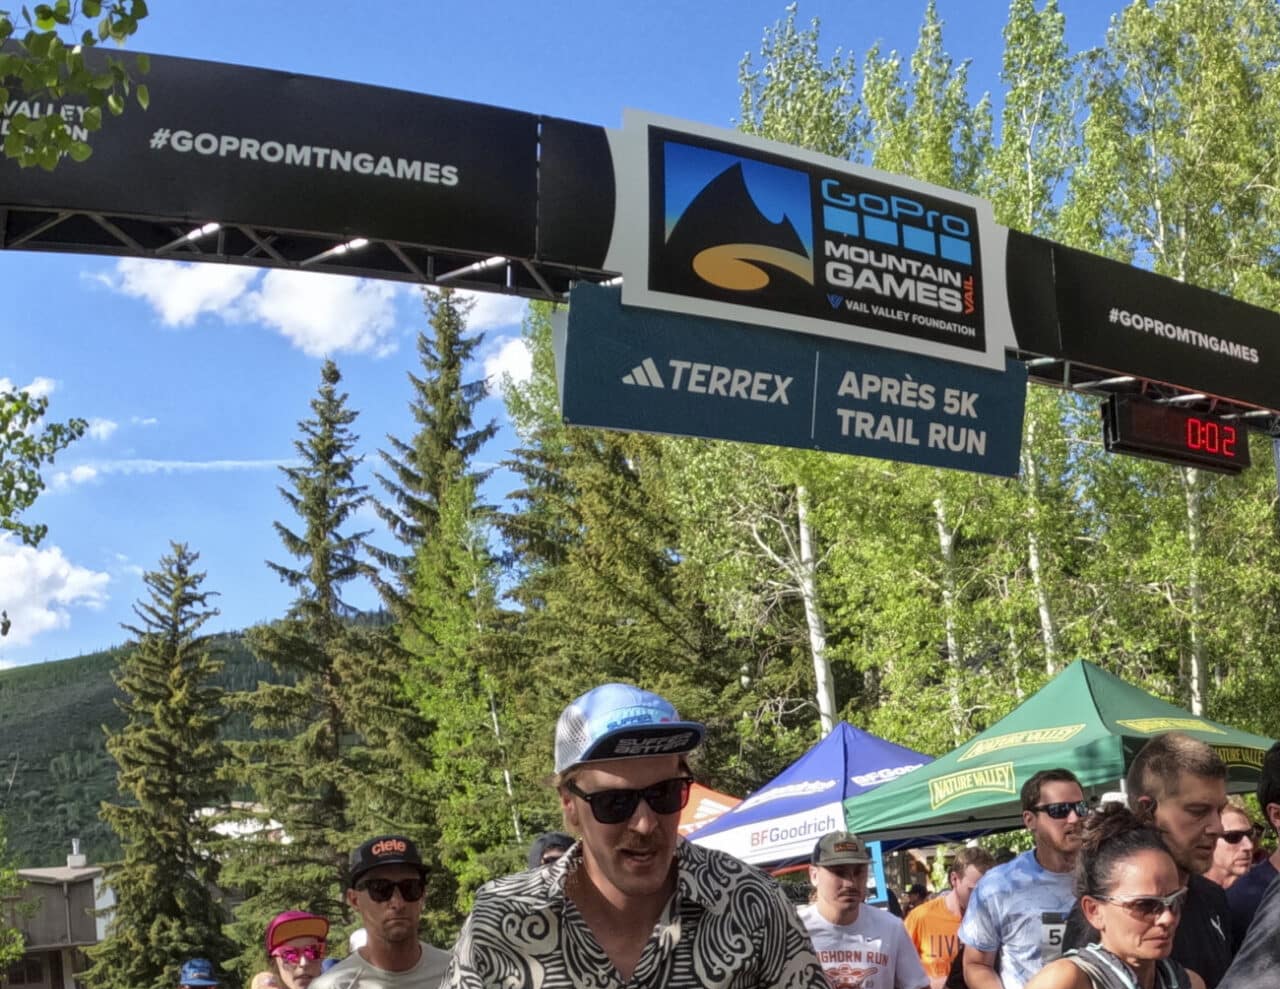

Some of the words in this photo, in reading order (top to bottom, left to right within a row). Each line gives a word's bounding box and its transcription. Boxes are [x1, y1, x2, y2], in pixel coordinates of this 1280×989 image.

[150, 127, 459, 187] #GOPROMTNGAMES
[821, 178, 970, 238] GoPro
[824, 240, 962, 287] MOUNTAIN
[825, 260, 963, 314] GAMES
[963, 275, 976, 315] VAIL
[845, 300, 870, 313] VAIL
[872, 304, 910, 322] VALLEY
[912, 311, 976, 337] FOUNDATION
[1109, 308, 1259, 363] #GOPROMTNGAMES
[669, 360, 794, 405] TERREX
[837, 371, 937, 412] APRÈS
[943, 389, 980, 418] 5K
[837, 408, 920, 447] TRAIL
[928, 425, 987, 456] RUN
[1186, 418, 1237, 457] 0:02
[934, 776, 972, 800] NATURE
[974, 765, 1010, 790] VALLEY
[751, 816, 836, 847] BFGoodrich
[867, 952, 889, 966] RUN
